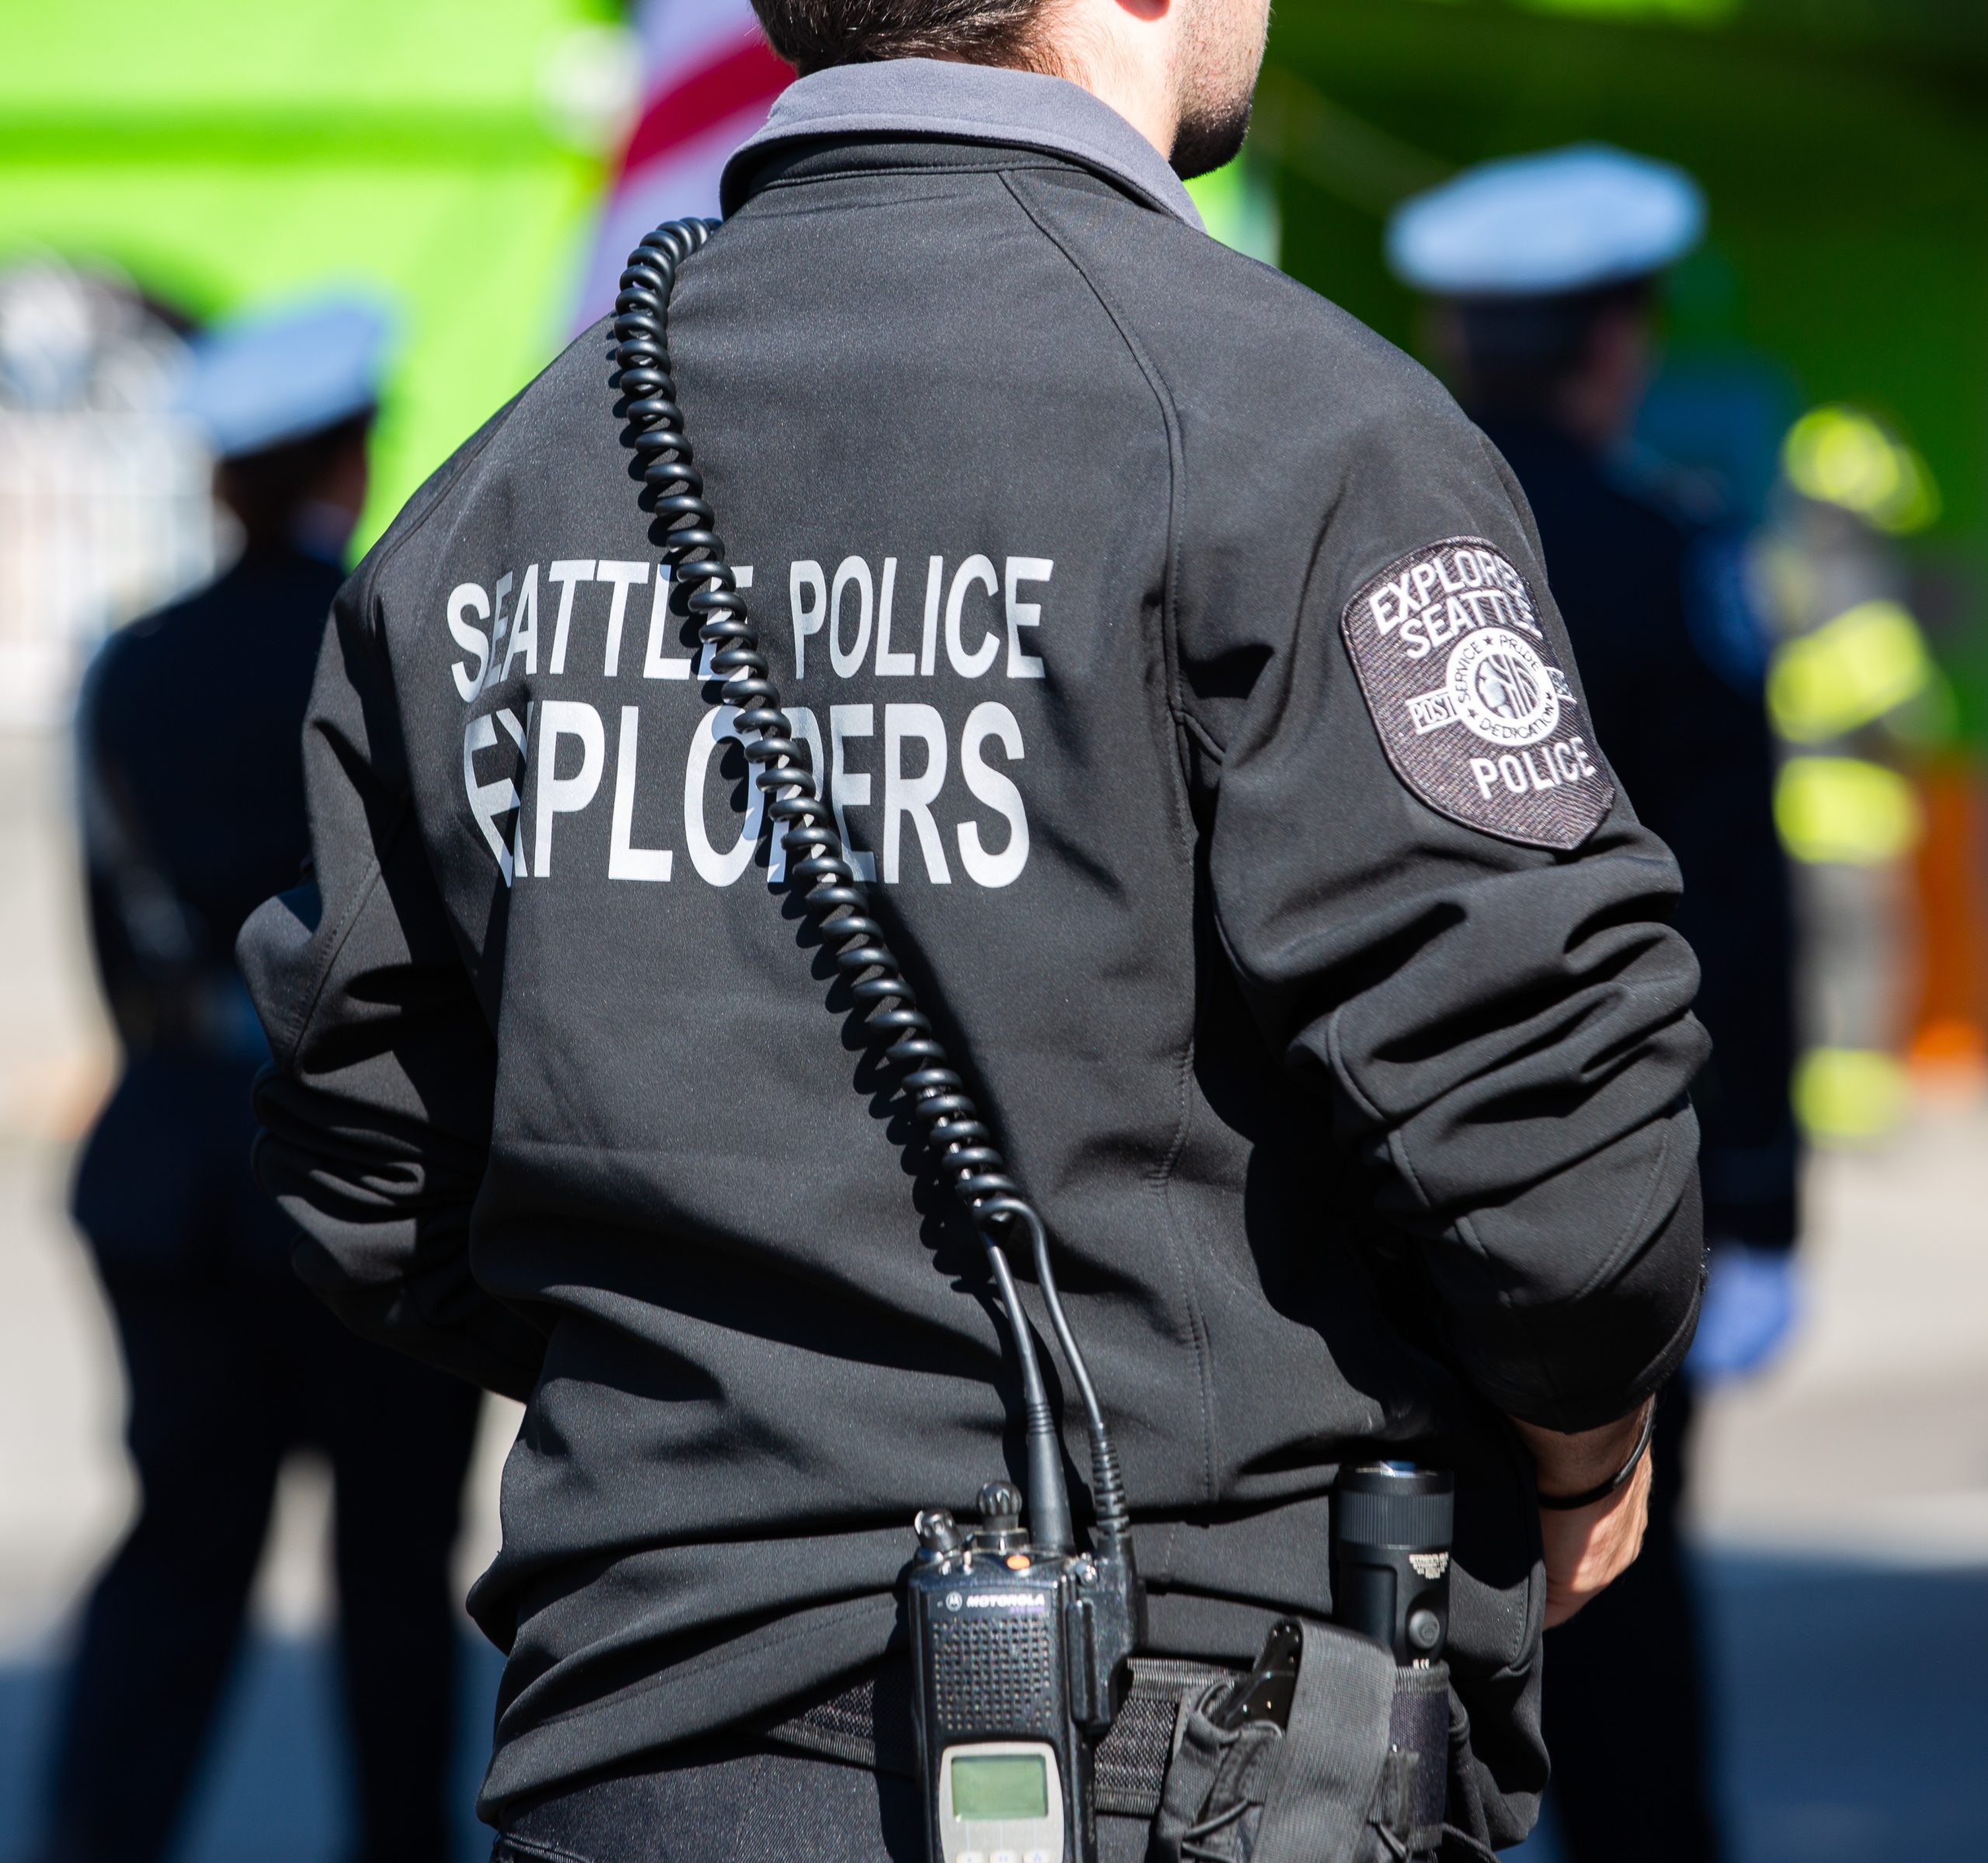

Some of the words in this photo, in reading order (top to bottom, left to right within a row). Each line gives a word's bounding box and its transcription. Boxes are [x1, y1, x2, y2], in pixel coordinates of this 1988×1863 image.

[789, 554, 1055, 680] POLICE
[1399, 590, 1544, 659] SEATTLE
[1455, 641, 1483, 704] SERVICE
[1500, 634, 1541, 672] PRIDE
[1409, 691, 1458, 732] POST
[1479, 703, 1554, 739] DEDICATION
[1470, 736, 1596, 800] POLICE
[966, 1594, 1045, 1608] MOTOROLA
